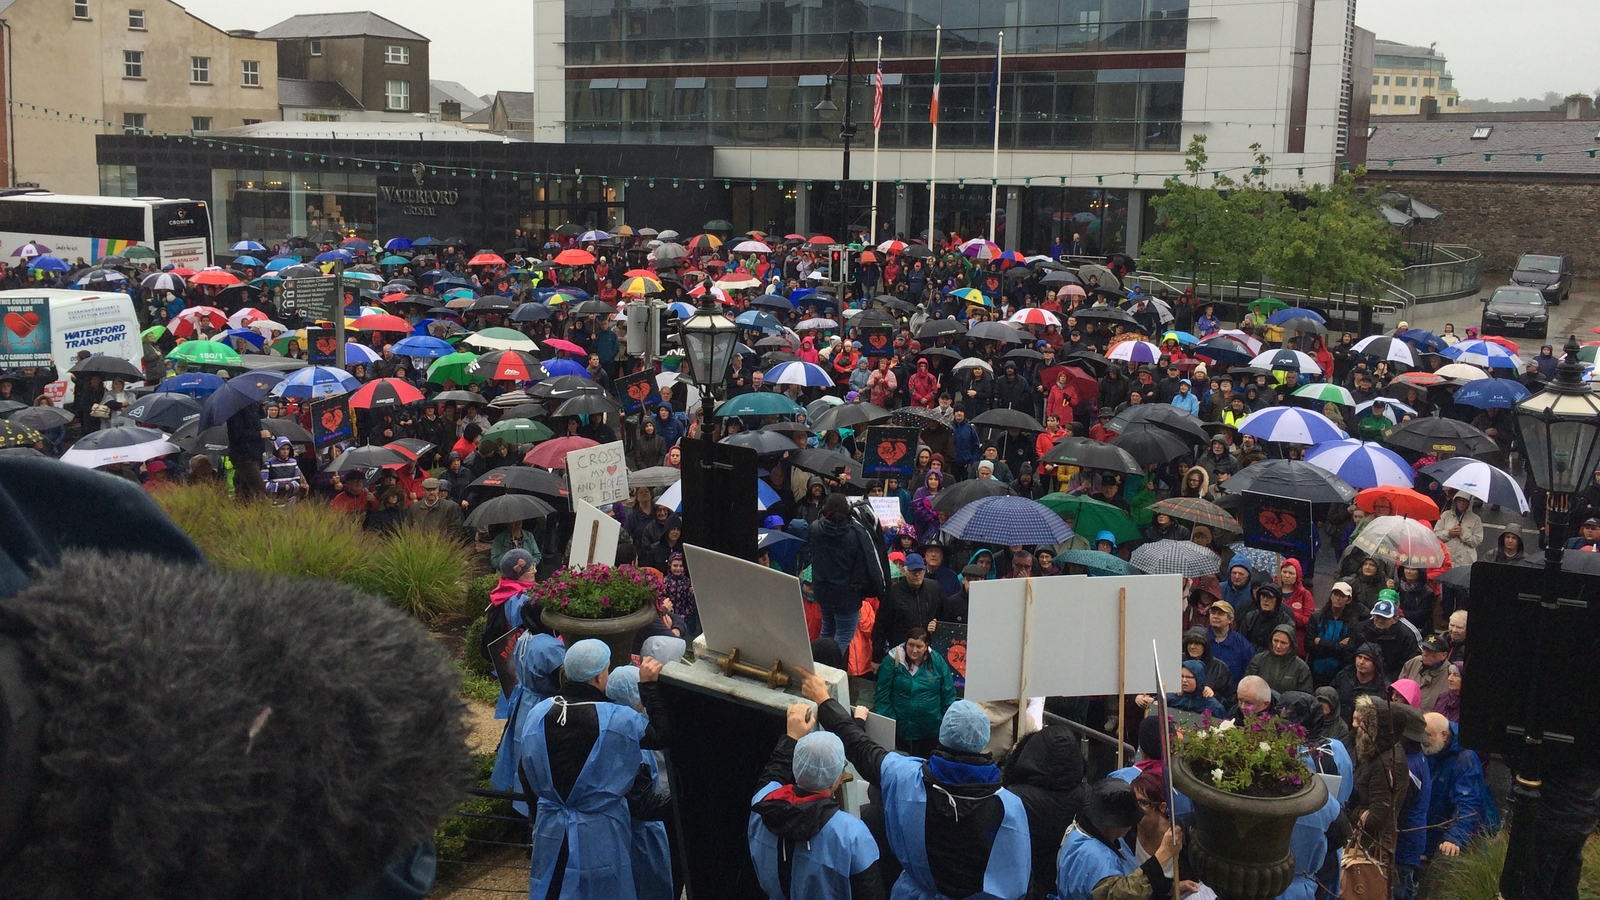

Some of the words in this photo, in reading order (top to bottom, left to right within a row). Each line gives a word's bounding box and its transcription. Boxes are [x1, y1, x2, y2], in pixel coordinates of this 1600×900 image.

[380, 186, 458, 205] WATERFORD
[404, 204, 436, 216] CRYSTAL
[64, 324, 126, 340] WATERFORD
[65, 332, 127, 349] TRANSPORT
[577, 447, 623, 469] CROSS
[591, 468, 608, 479] MY
[577, 481, 596, 493] AND
[600, 475, 624, 490] HOPE
[602, 488, 622, 502] DIE
